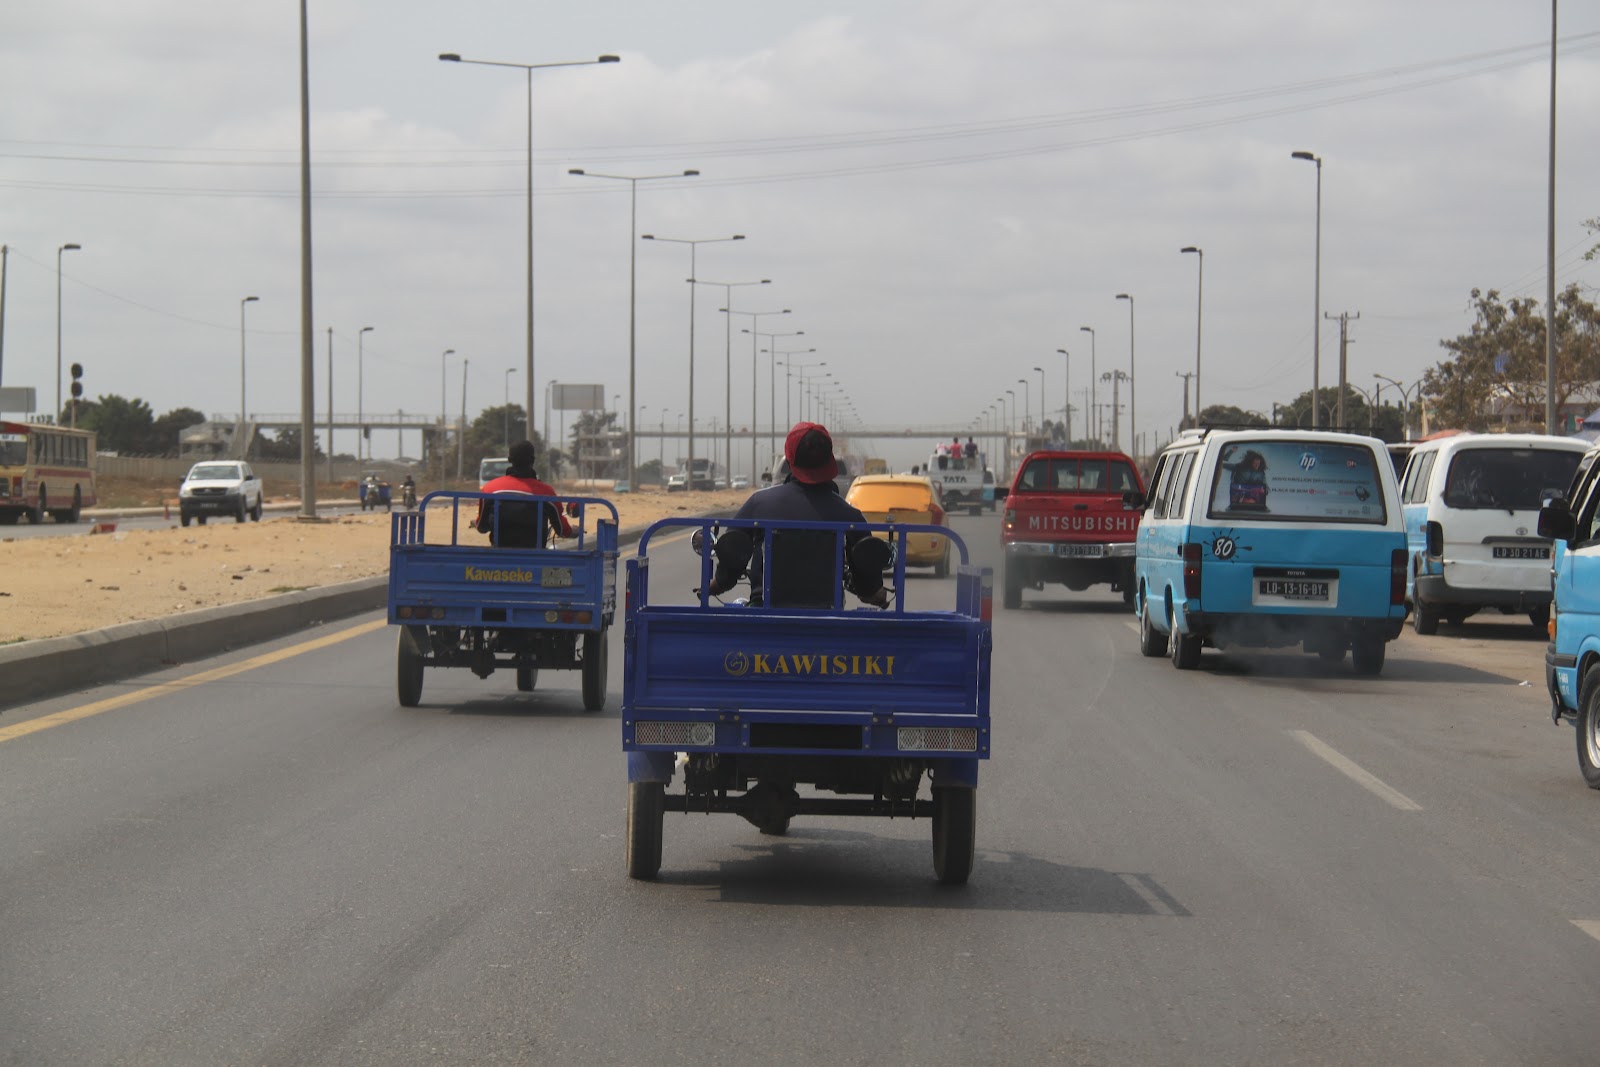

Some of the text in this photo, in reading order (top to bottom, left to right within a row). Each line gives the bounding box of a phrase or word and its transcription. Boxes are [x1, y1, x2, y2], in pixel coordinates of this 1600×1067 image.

[1300, 453, 1316, 471] hp
[1029, 516, 1135, 530] MITSUBISHI
[1214, 538, 1233, 556] 80
[465, 565, 533, 582] Kawaseke
[752, 654, 895, 675] KAWISIKI
